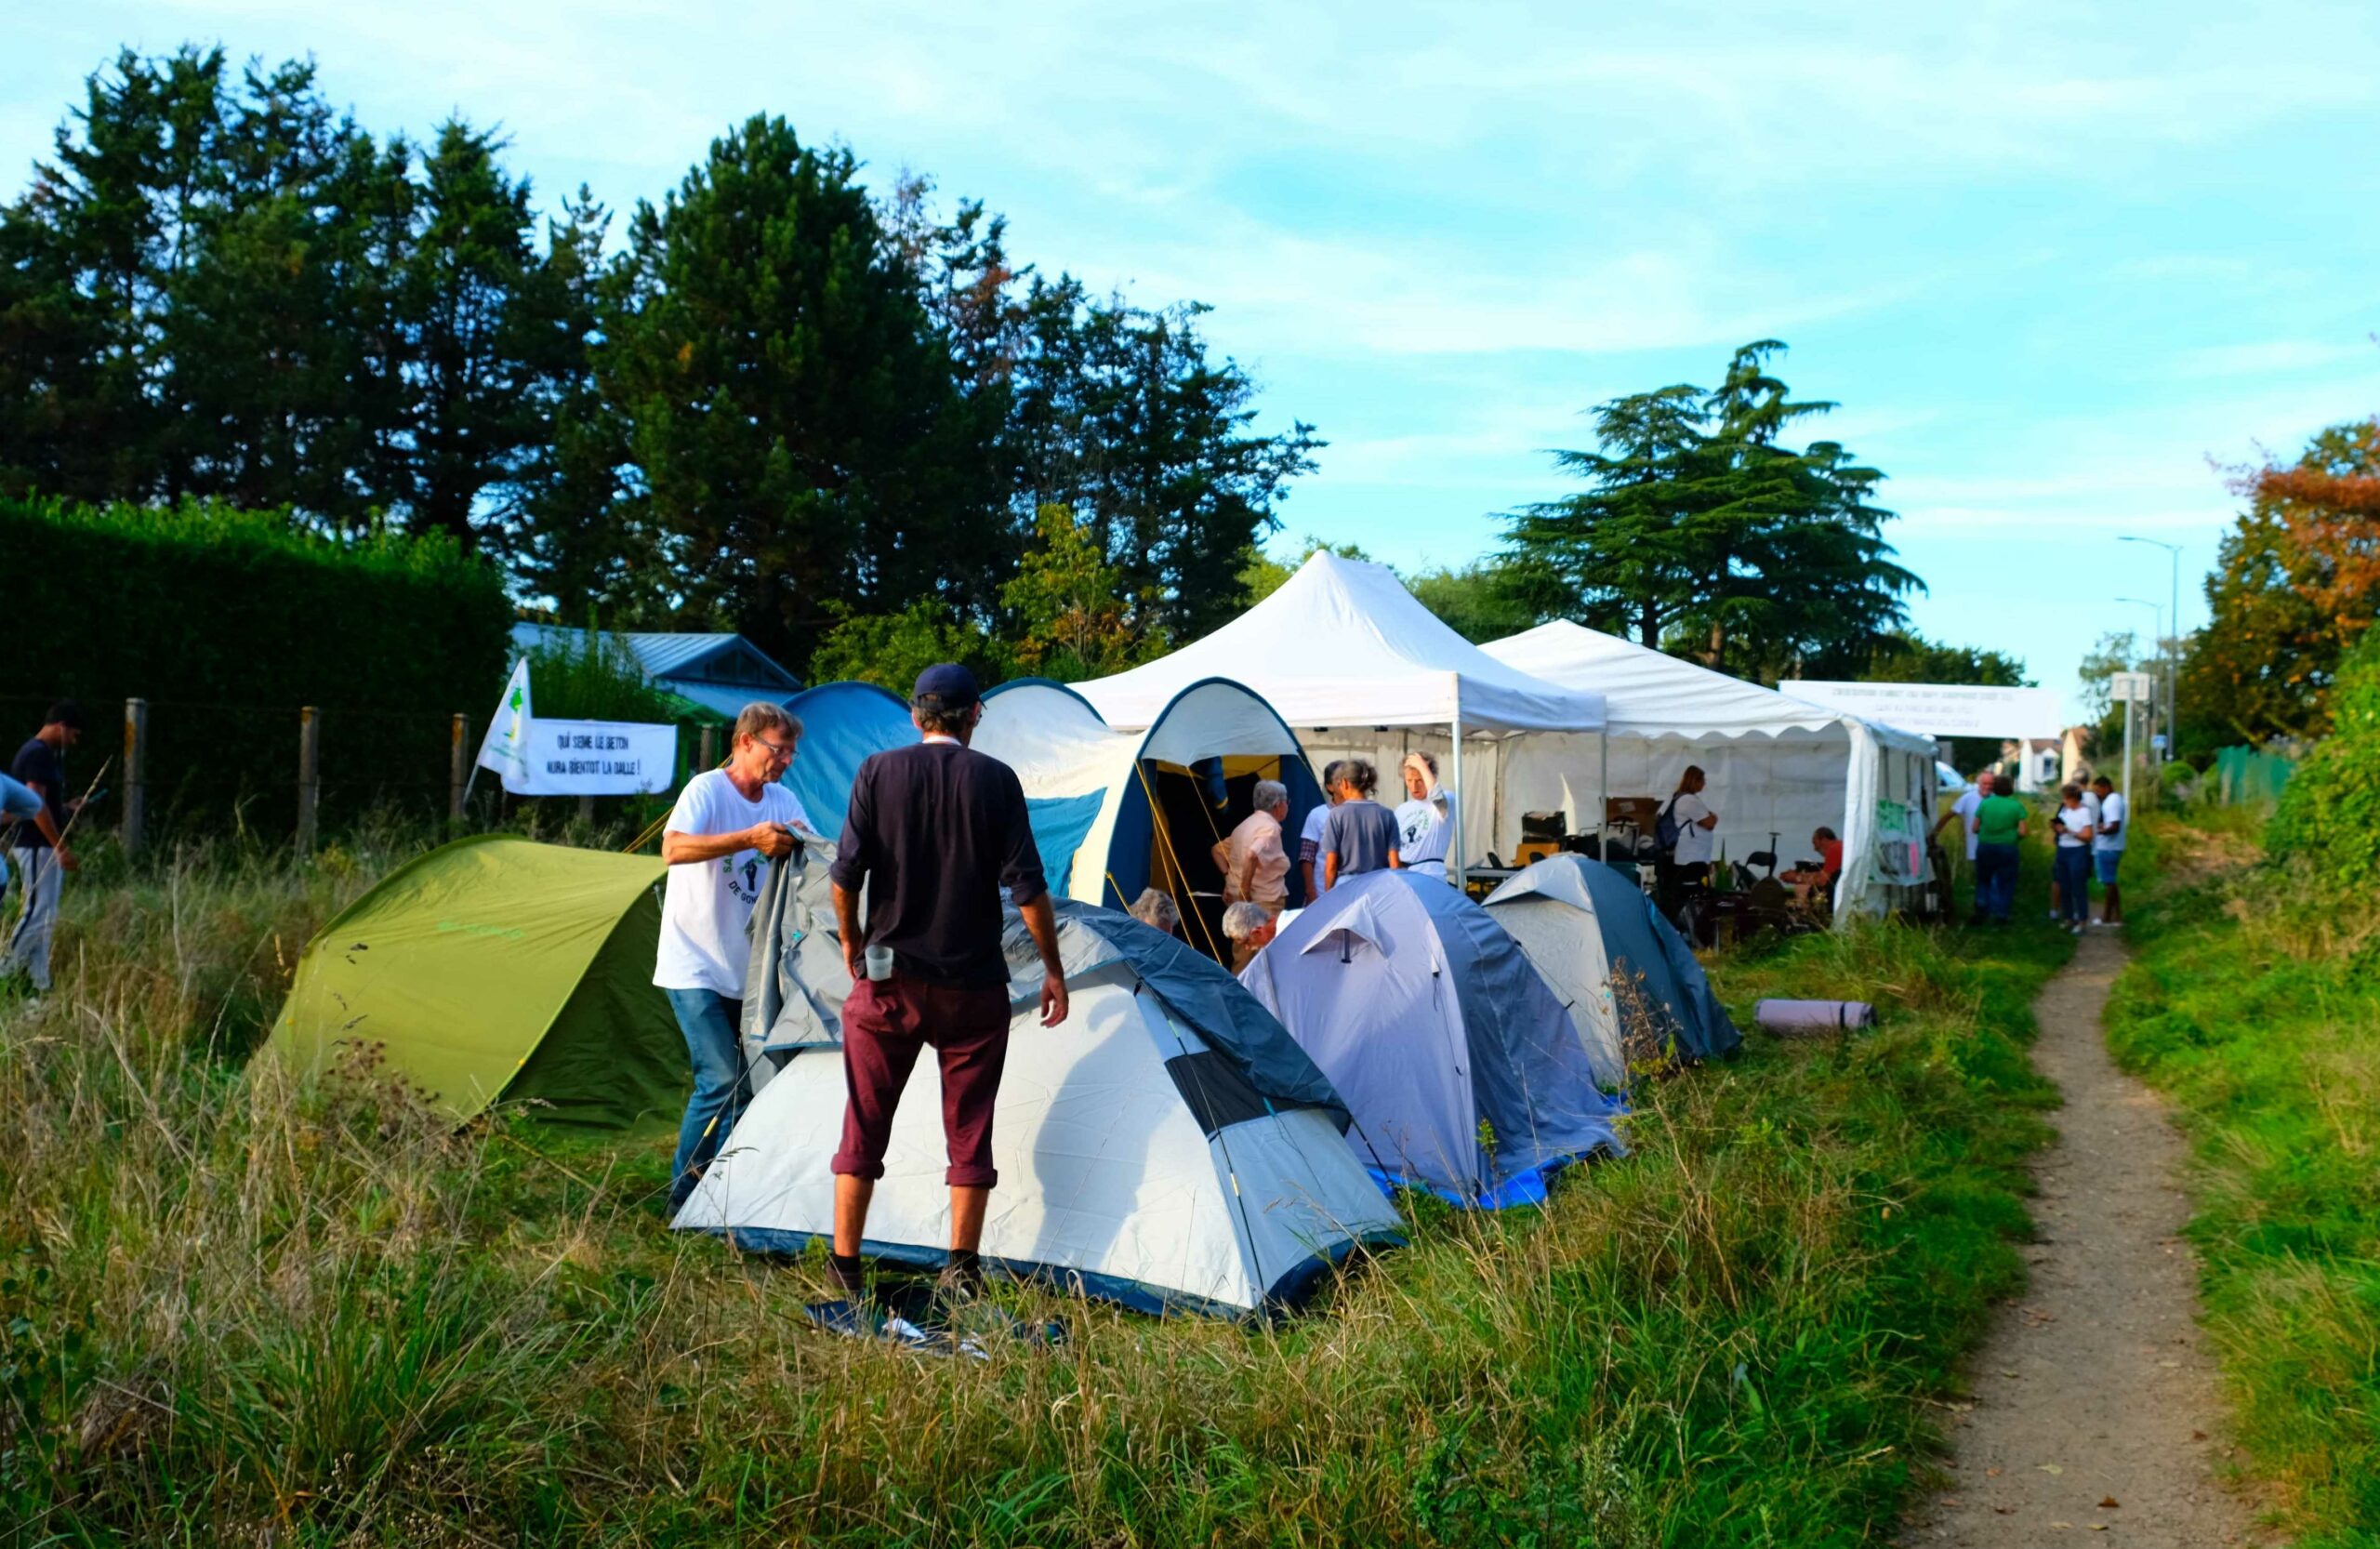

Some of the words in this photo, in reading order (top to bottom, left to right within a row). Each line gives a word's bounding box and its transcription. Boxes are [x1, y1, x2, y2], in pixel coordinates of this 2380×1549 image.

[595, 735, 603, 749] LE
[606, 736, 628, 750] BETON
[602, 761, 612, 774] LA
[728, 880, 742, 895] DE
